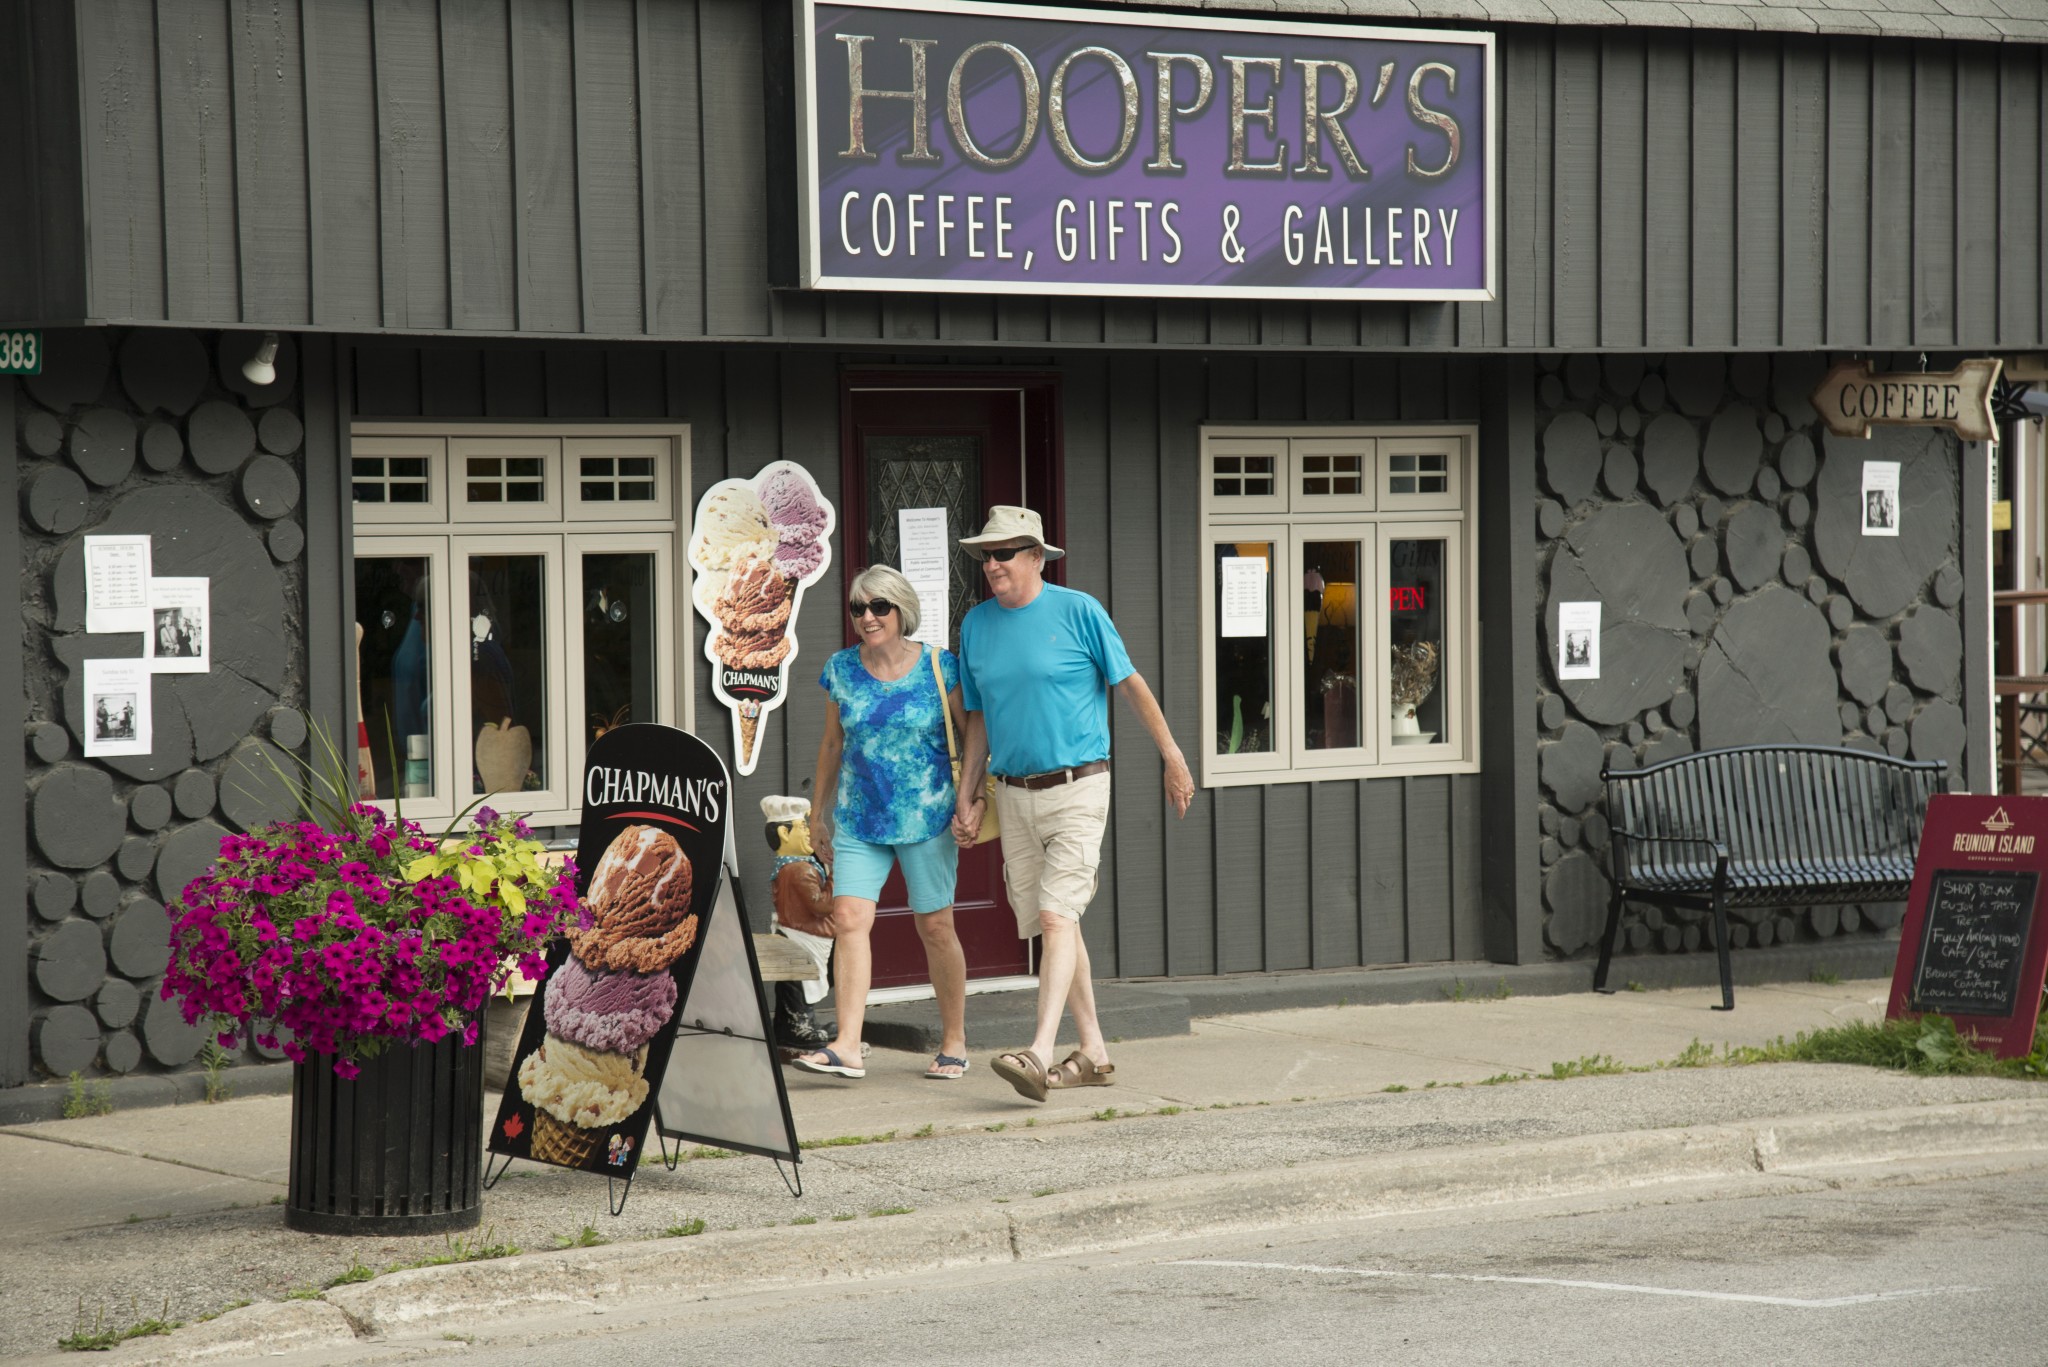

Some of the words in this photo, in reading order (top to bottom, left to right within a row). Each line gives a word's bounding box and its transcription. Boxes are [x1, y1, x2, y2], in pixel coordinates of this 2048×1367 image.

[835, 33, 1461, 179] HOOPER'S
[840, 191, 1034, 270] COFFEE,
[1055, 199, 1182, 264] GIFTS
[1221, 204, 1246, 264] &
[1283, 205, 1459, 267] GALLERY
[1839, 383, 1960, 420] COFFEE
[1390, 587, 1425, 611] PEN
[722, 671, 779, 692] CHAPMAN'S
[586, 765, 720, 823] CHAPMAN'S
[1952, 833, 1997, 853] REUNION
[1998, 835, 2035, 854] ISLAND
